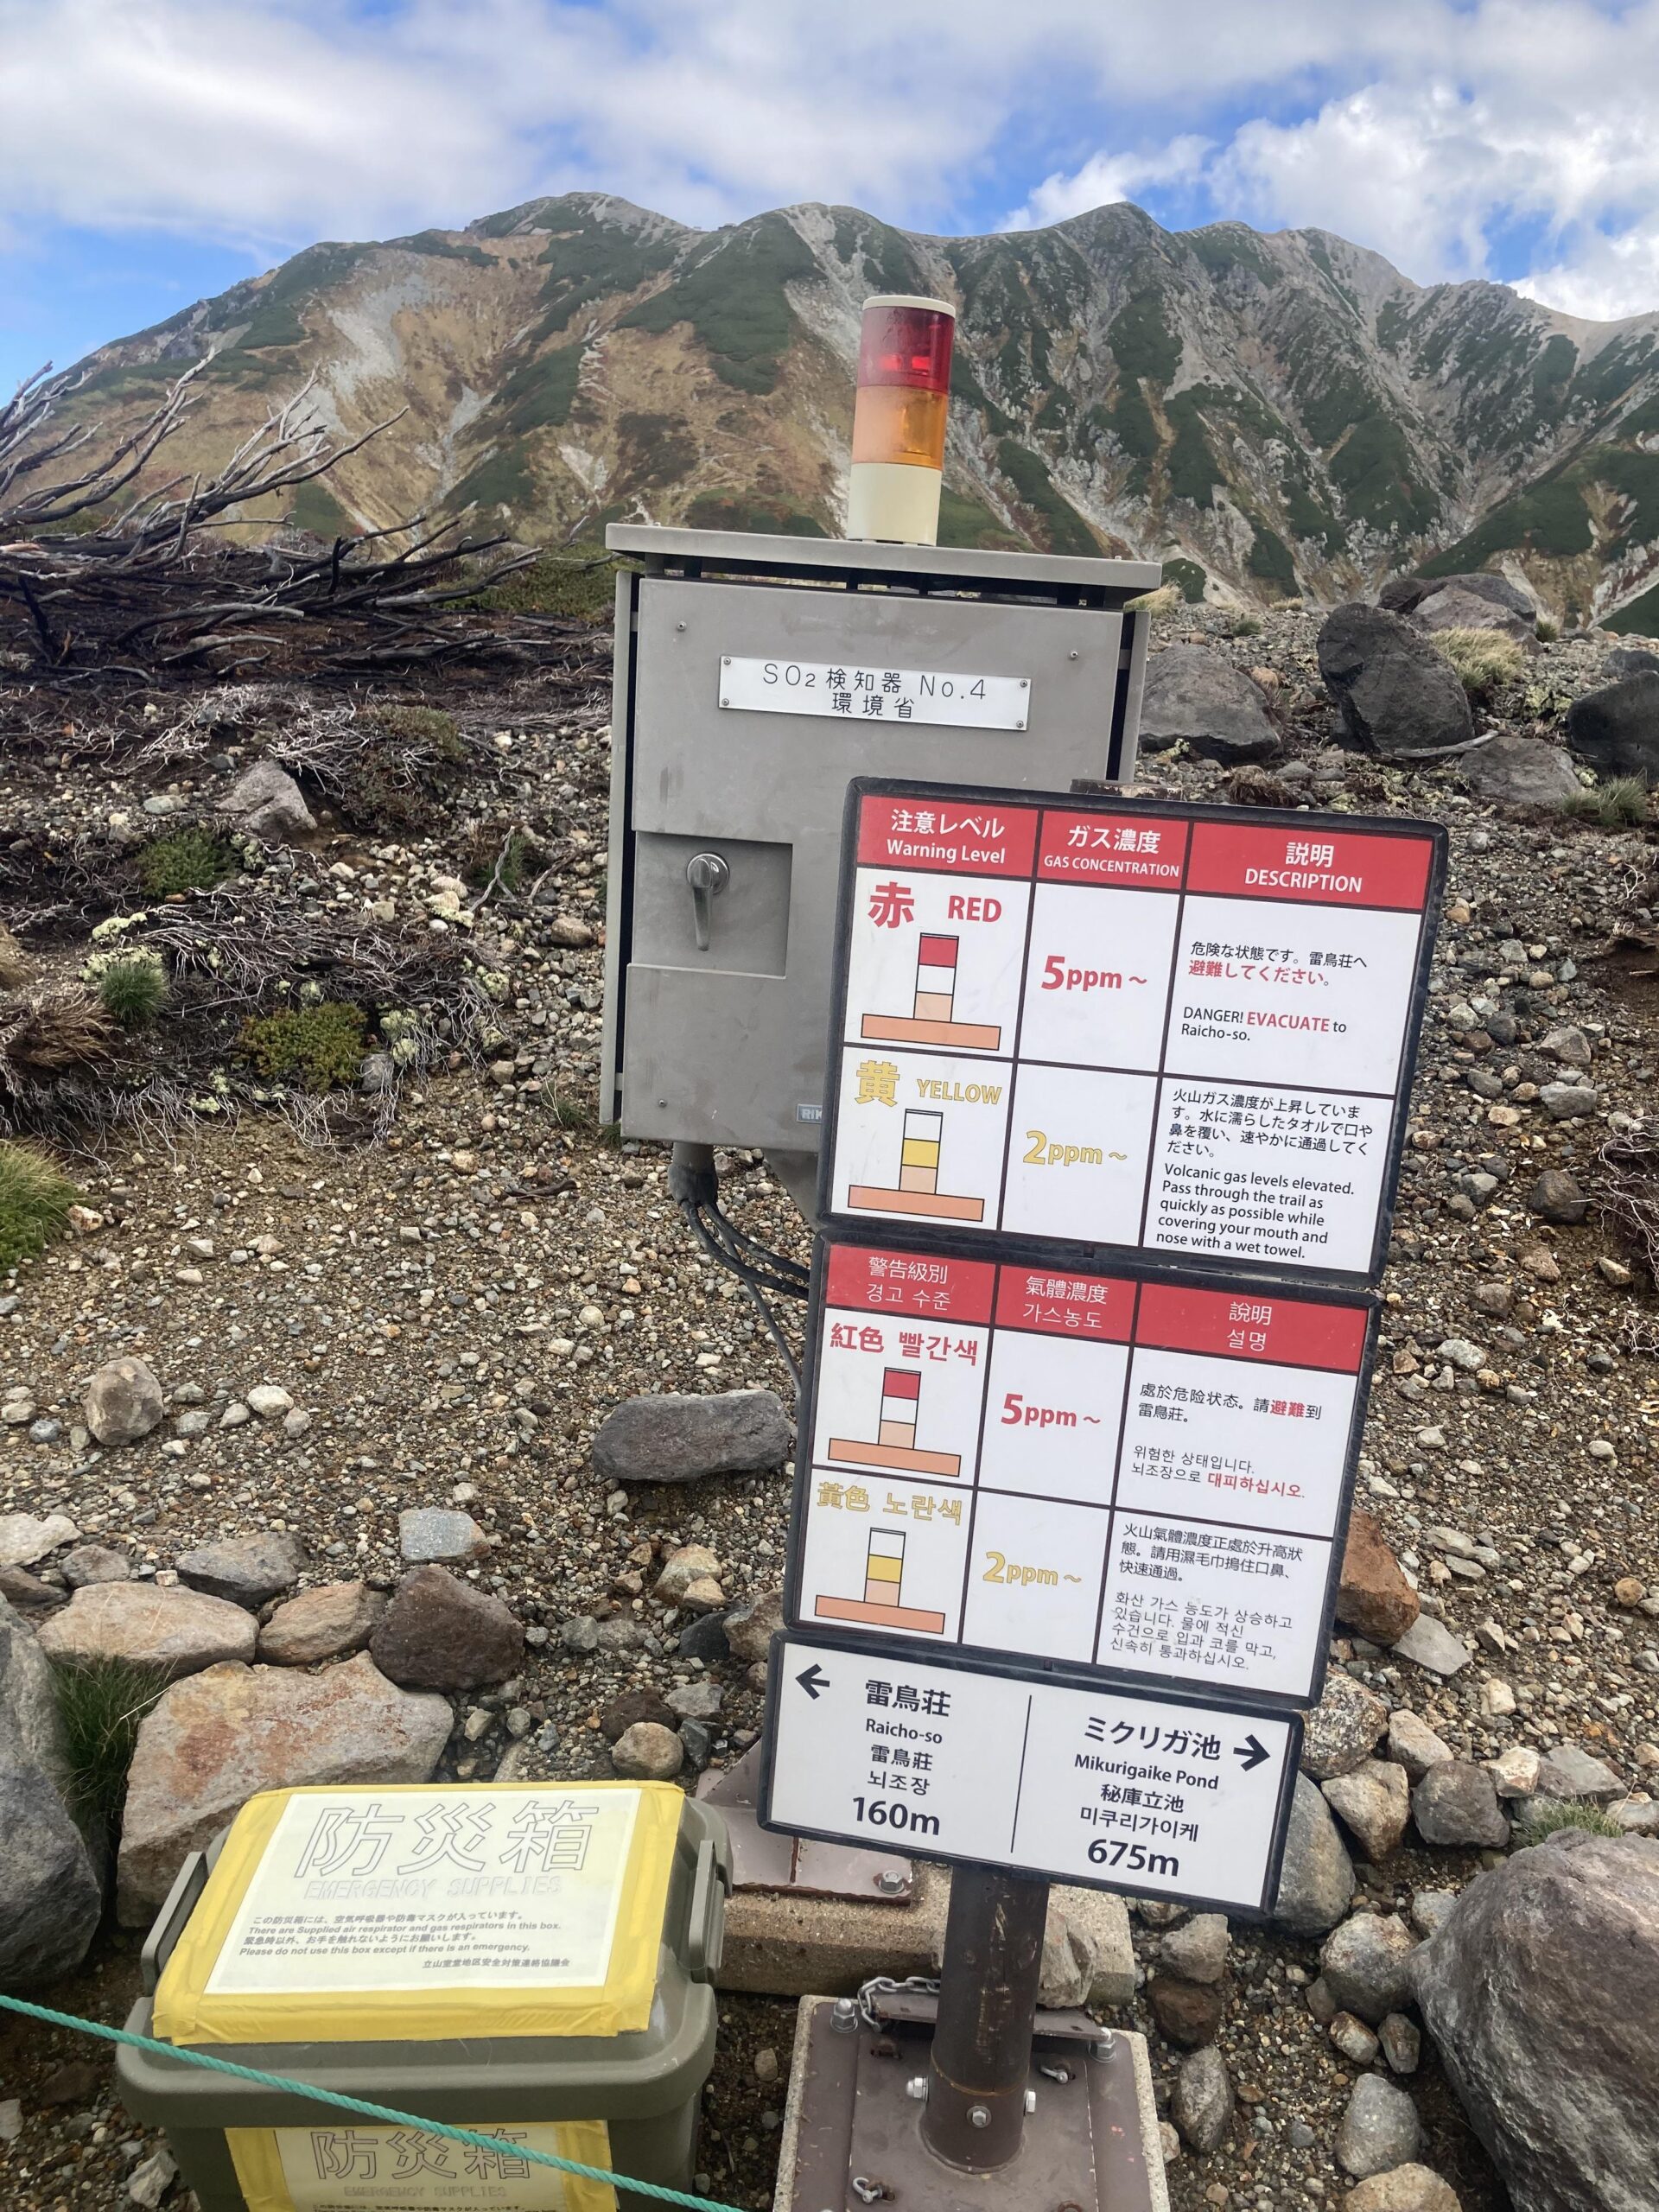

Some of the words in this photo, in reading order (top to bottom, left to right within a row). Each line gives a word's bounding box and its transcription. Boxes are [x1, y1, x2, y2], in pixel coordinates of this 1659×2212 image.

[919, 675, 986, 700] No.4
[832, 692, 915, 719] 環境省
[891, 809, 1005, 839] 注意レベル
[887, 839, 957, 864] Warning
[961, 845, 1005, 864] Level
[1068, 825, 1160, 855] ガス濃度
[1044, 855, 1070, 869] GAS
[1072, 857, 1179, 878] CONCENTRATION
[1286, 842, 1333, 868] 説明
[1244, 868, 1362, 893] DESCRIPTION
[868, 881, 915, 929] 赤
[947, 894, 1002, 923] RED
[1188, 959, 1329, 986] 避難してください。
[1181, 1024, 1250, 1041] Raicho-so.
[1183, 1007, 1243, 1024] DANGER!
[1247, 1011, 1330, 1033] EVACUATE
[1333, 1021, 1347, 1033] to
[855, 1060, 900, 1107] 黄
[917, 1078, 1002, 1105] YELLOW
[1173, 1088, 1361, 1119] 火山ガス濃度が上昇していま
[1166, 1141, 1215, 1159] ださい。
[1165, 1163, 1221, 1181] Volcanic
[1224, 1173, 1247, 1185] gas
[1250, 1172, 1288, 1188] levels
[1292, 1177, 1354, 1195] elevated.
[1162, 1180, 1192, 1194] Pass
[1195, 1184, 1249, 1203] through
[1253, 1192, 1275, 1203] the
[1279, 1194, 1306, 1207] trail
[1308, 1198, 1323, 1209] as
[1160, 1198, 1208, 1216] quickly
[1211, 1205, 1225, 1216] as
[1228, 1205, 1284, 1222] possible
[1287, 1213, 1325, 1226] while
[1158, 1215, 1216, 1234] covering
[1219, 1222, 1250, 1236] your
[1253, 1226, 1299, 1241] mouth
[1302, 1231, 1328, 1244] and
[1156, 1232, 1188, 1245] nose
[1191, 1236, 1221, 1249] with
[1224, 1240, 1231, 1249] a
[1235, 1242, 1261, 1254] wet
[1263, 1244, 1306, 1259] towel.
[868, 1256, 948, 1285] 警告級別
[865, 1283, 904, 1303] 경고
[912, 1290, 951, 1312] 수준
[1025, 1275, 1109, 1306] 氣體濃度
[1022, 1303, 1103, 1329] 가스농도
[830, 1322, 885, 1353] 紅色
[899, 1331, 978, 1367] 빨간색
[1227, 1329, 1266, 1352] 설명
[1134, 1445, 1175, 1463] 위험한
[1181, 1452, 1255, 1474] 상태입니다.
[1131, 1462, 1201, 1483] 뇌조장으로
[1207, 1472, 1306, 1498] 대피하십시오.
[882, 1492, 963, 1526] 노란색
[1119, 1560, 1183, 1582] 快速通過。
[1115, 1591, 1145, 1608] 화산
[1150, 1597, 1179, 1612] 가스
[1185, 1601, 1229, 1621] 농도가
[1235, 1609, 1293, 1629] 상승하고
[1115, 1606, 1174, 1628] 있습니다.
[1181, 1617, 1210, 1634] 물에
[1216, 1622, 1244, 1639] 적신
[1111, 1637, 1153, 1656] 신속히
[1159, 1644, 1249, 1670] 통과하십시오.
[1112, 1622, 1169, 1642] 수건으로
[1177, 1630, 1204, 1649] 입과
[1210, 1637, 1238, 1653] 코를
[1245, 1642, 1276, 1660] 막고,
[865, 1679, 951, 1717] 雷鳥荘
[865, 1718, 943, 1745] Raicho-so
[1084, 1716, 1221, 1761] ミクリガ池
[870, 1744, 933, 1771] 雷鳥莊
[1074, 1753, 1173, 1783] Mikurigaike
[1176, 1770, 1219, 1789] Pond
[867, 1770, 931, 1796] 뇌조장
[1100, 1783, 1185, 1814] 秘庫立池
[852, 1796, 941, 1836] 160m
[1080, 1806, 1199, 1842] 미쿠리가이케
[295, 1799, 600, 1878] 防災箱
[1087, 1838, 1180, 1877] 675m
[306, 1878, 436, 1899] EMERGENCY
[447, 1876, 562, 1897] SUPPLIES
[249, 1926, 276, 1936] There
[296, 1925, 340, 1936] Supplied
[343, 1925, 357, 1934] air
[359, 1924, 406, 1935] respirator
[409, 1923, 428, 1932] and
[430, 1924, 448, 1934] gas
[450, 1922, 504, 1933] respirators
[507, 1922, 516, 1930] in
[518, 1921, 537, 1929] this
[540, 1921, 562, 1929] box.
[239, 1948, 273, 1956] Please
[275, 1947, 288, 1955] do
[331, 1946, 349, 1955] this
[352, 1946, 371, 1955] box
[372, 1945, 407, 1955] except
[409, 1944, 417, 1953] if
[418, 1944, 443, 1953] there
[473, 1943, 530, 1954] emergency.
[310, 2127, 531, 2180] 防災箱
